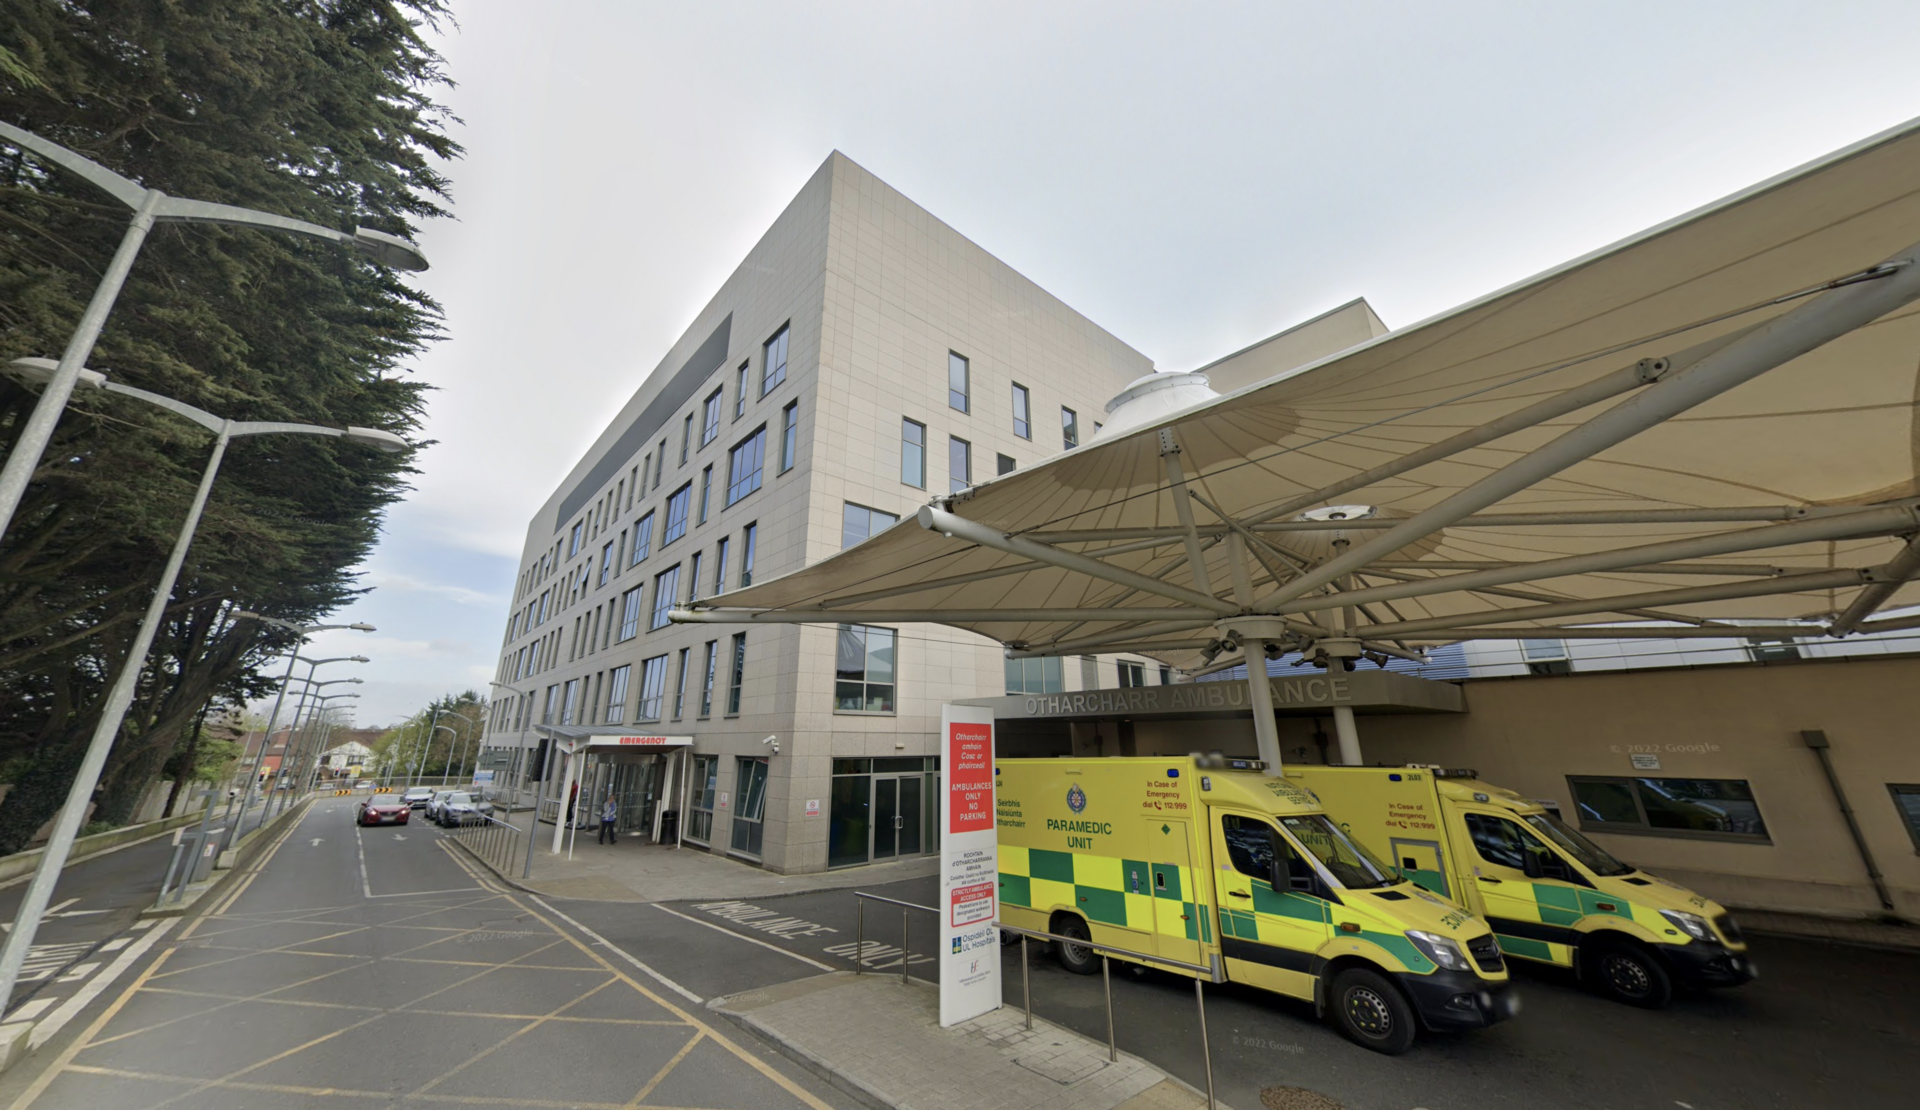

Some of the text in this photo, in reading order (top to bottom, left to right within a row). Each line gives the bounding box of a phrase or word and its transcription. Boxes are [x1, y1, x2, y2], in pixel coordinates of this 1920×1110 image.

[1026, 690, 1159, 716] OTHARCHARR
[952, 782, 992, 791] AMBULANCES
[1146, 790, 1180, 800] Emergency
[960, 812, 986, 820] PARKING
[1389, 811, 1426, 820] Emergency
[1047, 819, 1112, 835] PARAMEDIC
[1068, 836, 1092, 849] UNIT
[1301, 834, 1328, 845] UNIT
[952, 884, 992, 896] STRICTLY AMBULANCE
[691, 900, 838, 940] AMBULANCE
[972, 936, 996, 949] Hospitals
[823, 940, 936, 970] ONLY
